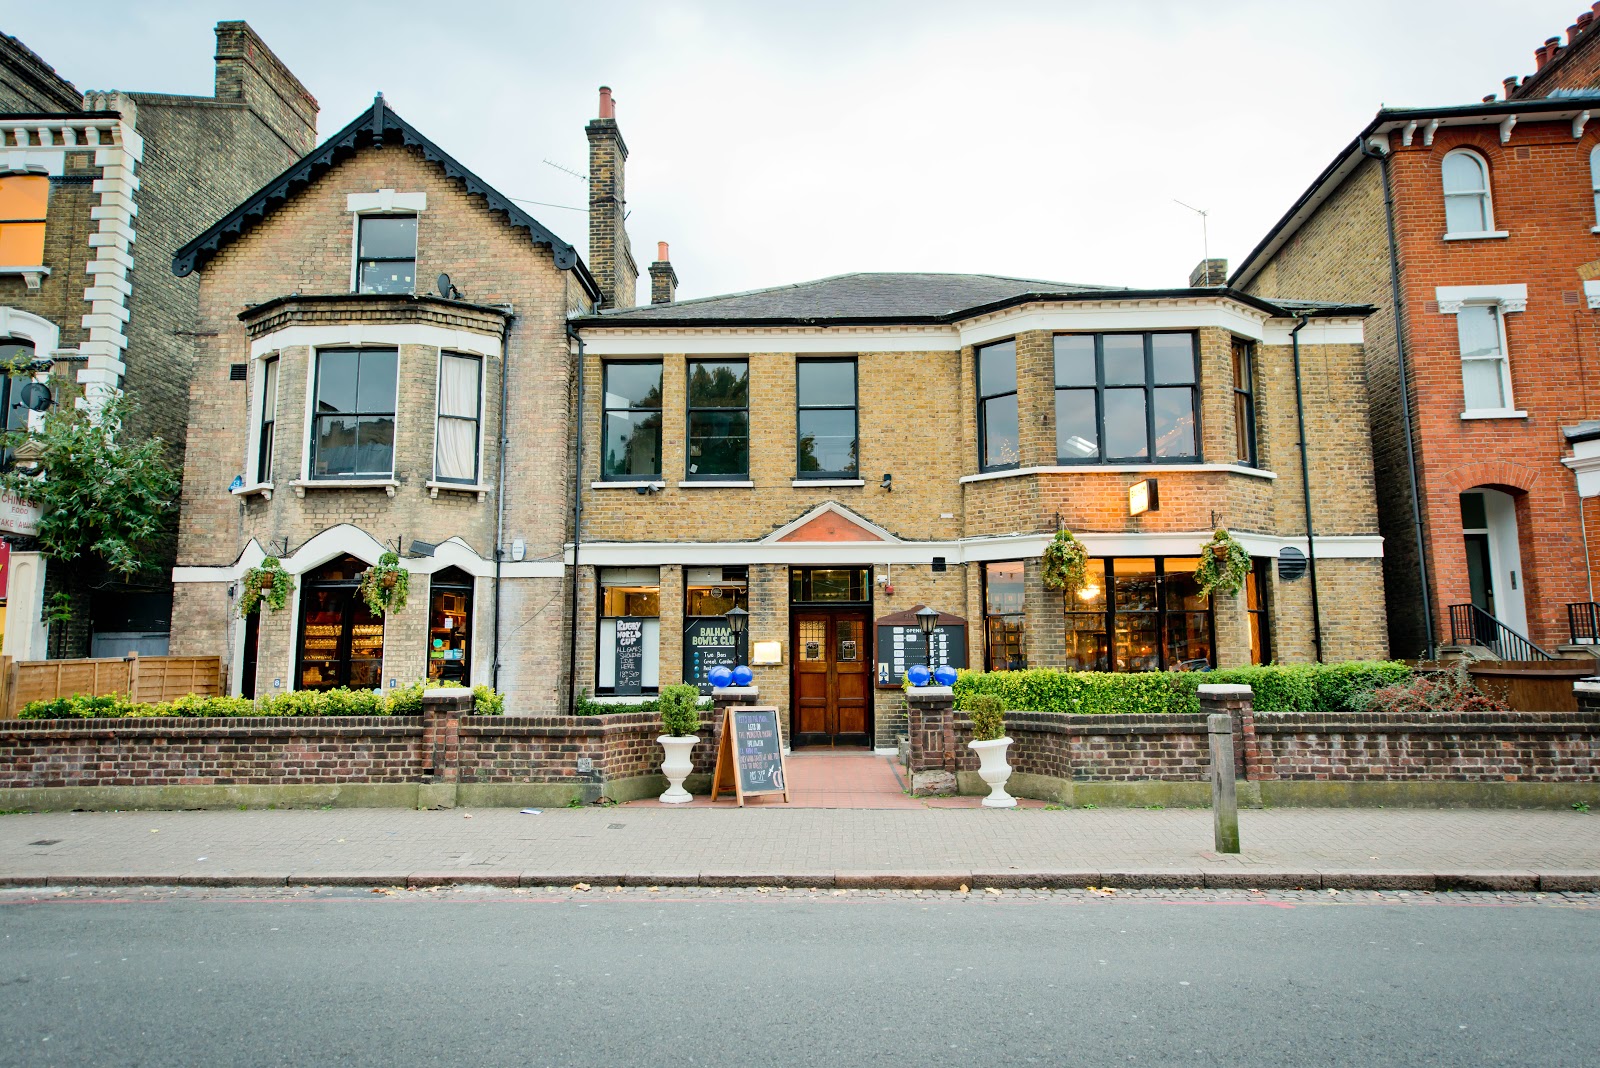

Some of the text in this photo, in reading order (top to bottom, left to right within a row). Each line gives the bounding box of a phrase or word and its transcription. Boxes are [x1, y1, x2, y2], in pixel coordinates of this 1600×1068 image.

[2, 493, 38, 508] CHINESE
[617, 631, 641, 639] WORLD
[692, 636, 740, 646] BOWLS CLU
